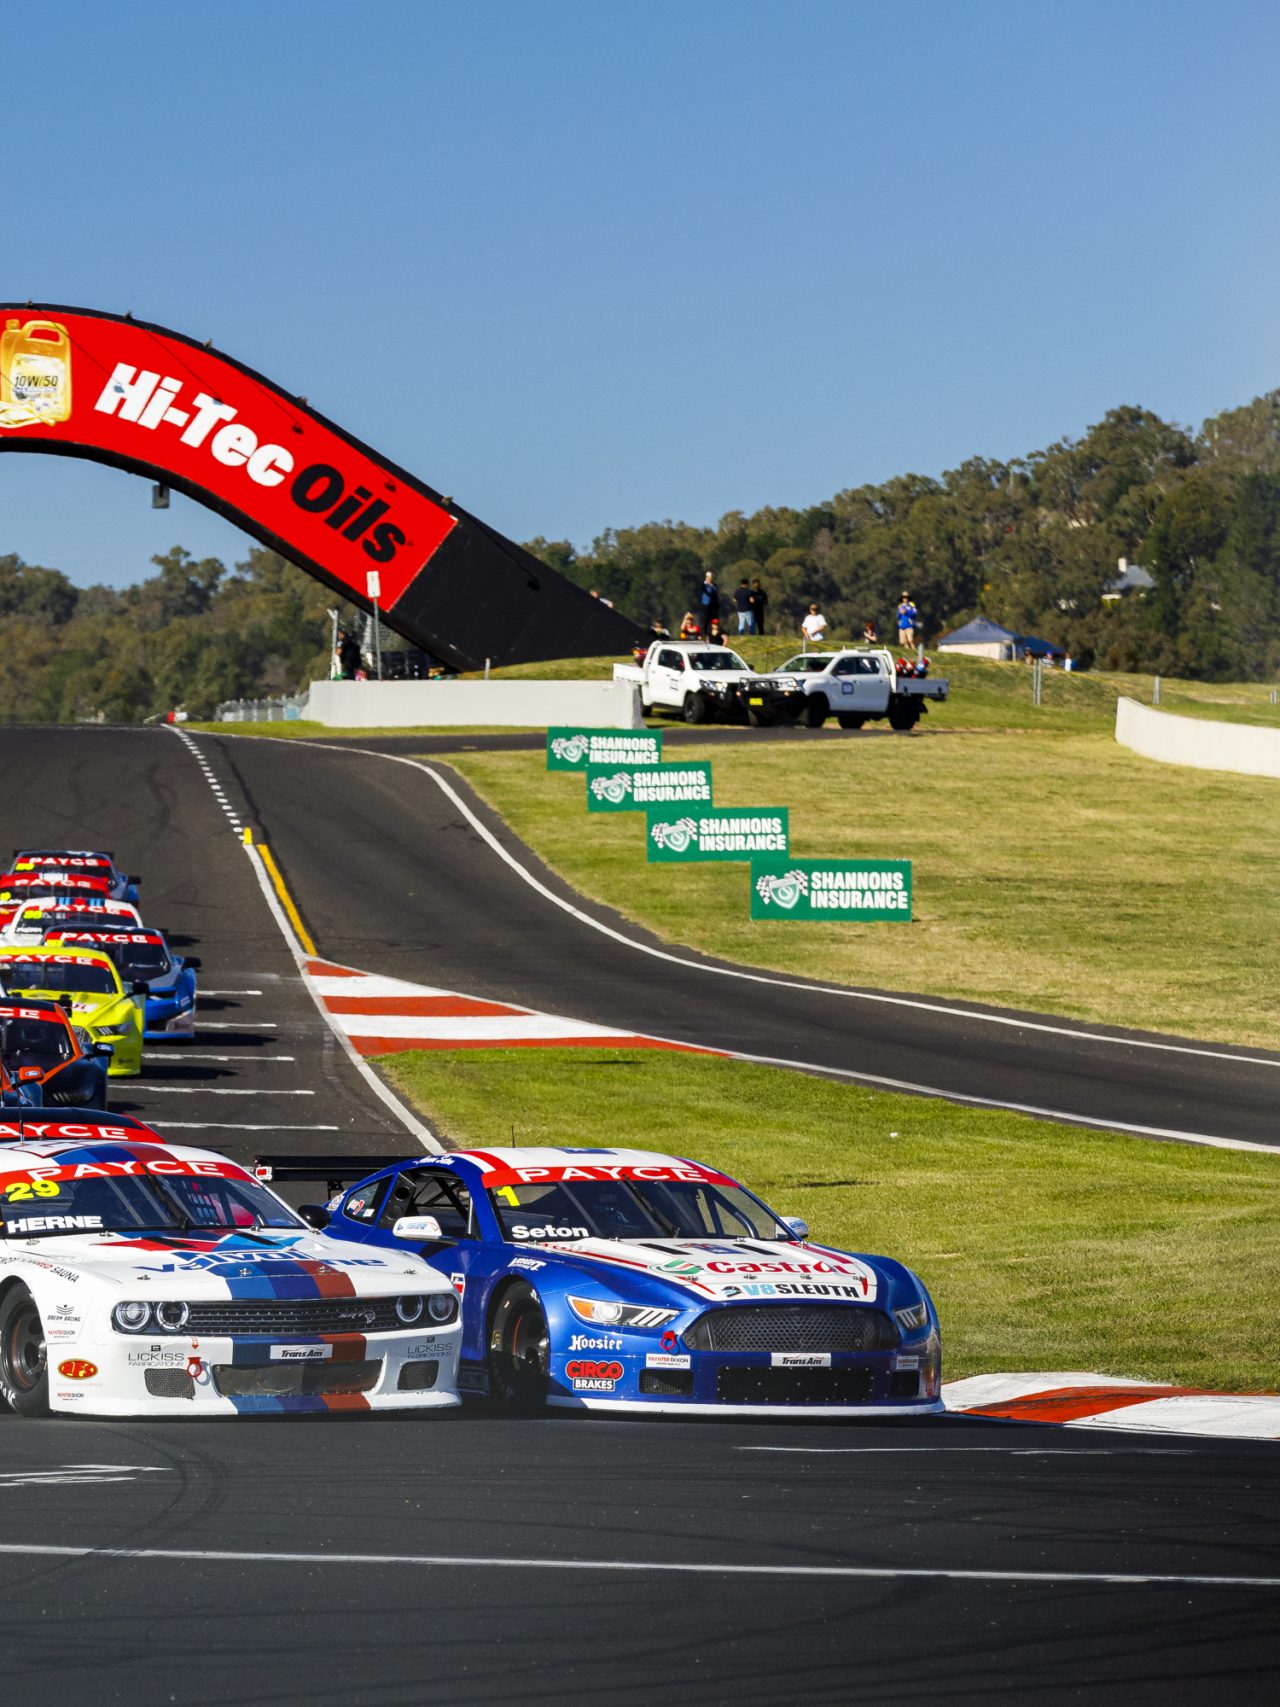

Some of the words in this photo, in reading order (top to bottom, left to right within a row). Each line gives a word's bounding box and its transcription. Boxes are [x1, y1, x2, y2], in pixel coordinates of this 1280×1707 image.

[94, 362, 294, 487] Hi-Tec
[291, 463, 406, 563] Oils
[589, 736, 656, 750] SHANNONS
[589, 750, 658, 764] INSURANCE
[633, 770, 706, 786] SHANNONS
[633, 785, 710, 801] INSURANCE
[699, 817, 782, 834] SHANNONS
[699, 834, 786, 851] INSURANCE
[811, 871, 903, 890] SHANNONS
[811, 890, 908, 909] INSURANCE
[60, 933, 148, 943] PAYCE
[26, 1161, 224, 1182] PAYCE
[516, 1167, 708, 1183] PAYCE
[5, 1180, 60, 1202] 29
[497, 1186, 520, 1207] 1
[7, 1216, 103, 1234] HERNE
[511, 1225, 590, 1239] Seton
[50, 1266, 80, 1283] SAUNA
[707, 1261, 856, 1275] Castrol
[407, 1343, 453, 1354] LICKISS
[569, 1334, 623, 1351] Hoosier
[128, 1353, 184, 1361] LICKISS
[281, 1350, 306, 1358] Trans
[782, 1357, 805, 1365] Trans
[807, 1357, 823, 1365] Am
[566, 1361, 623, 1380] CIRCO
[575, 1380, 613, 1391] BRAKES
